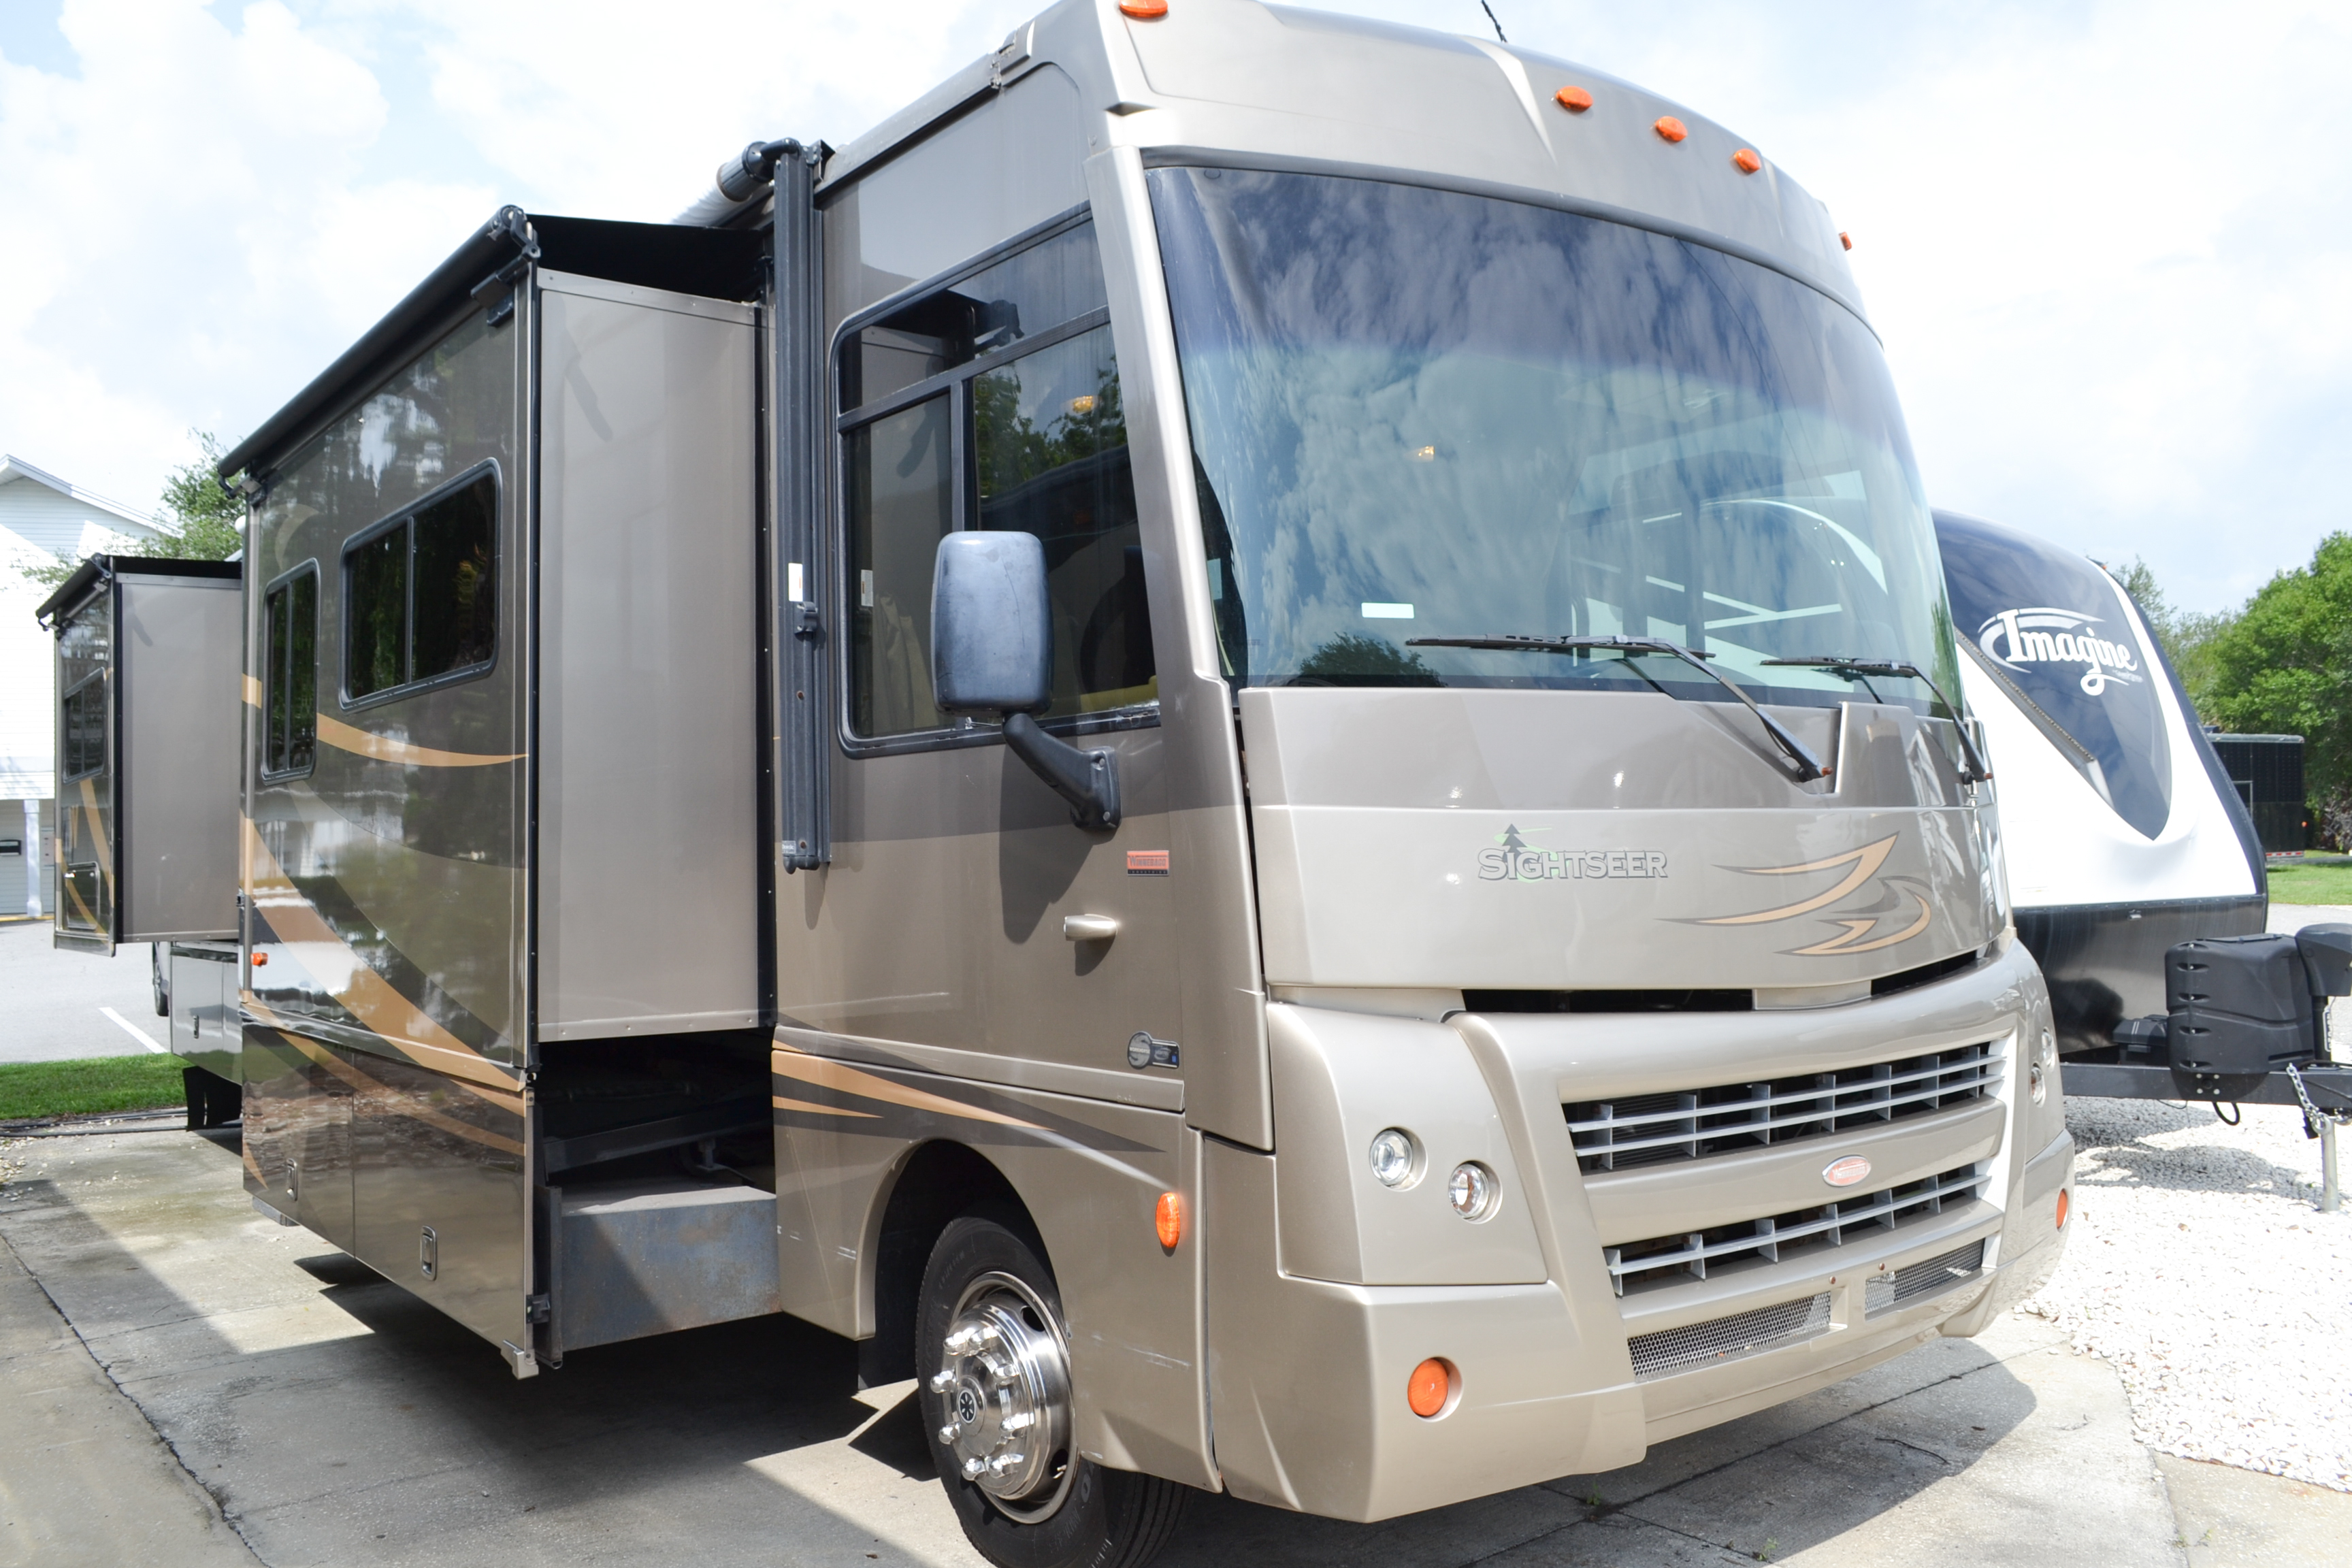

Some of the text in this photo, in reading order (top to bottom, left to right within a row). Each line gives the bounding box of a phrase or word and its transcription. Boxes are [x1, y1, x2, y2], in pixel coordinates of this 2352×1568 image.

[1997, 609, 2138, 696] Imagine
[1130, 855, 1166, 866] WINNEBAGO
[1477, 848, 1669, 880] SIGHTSEER
